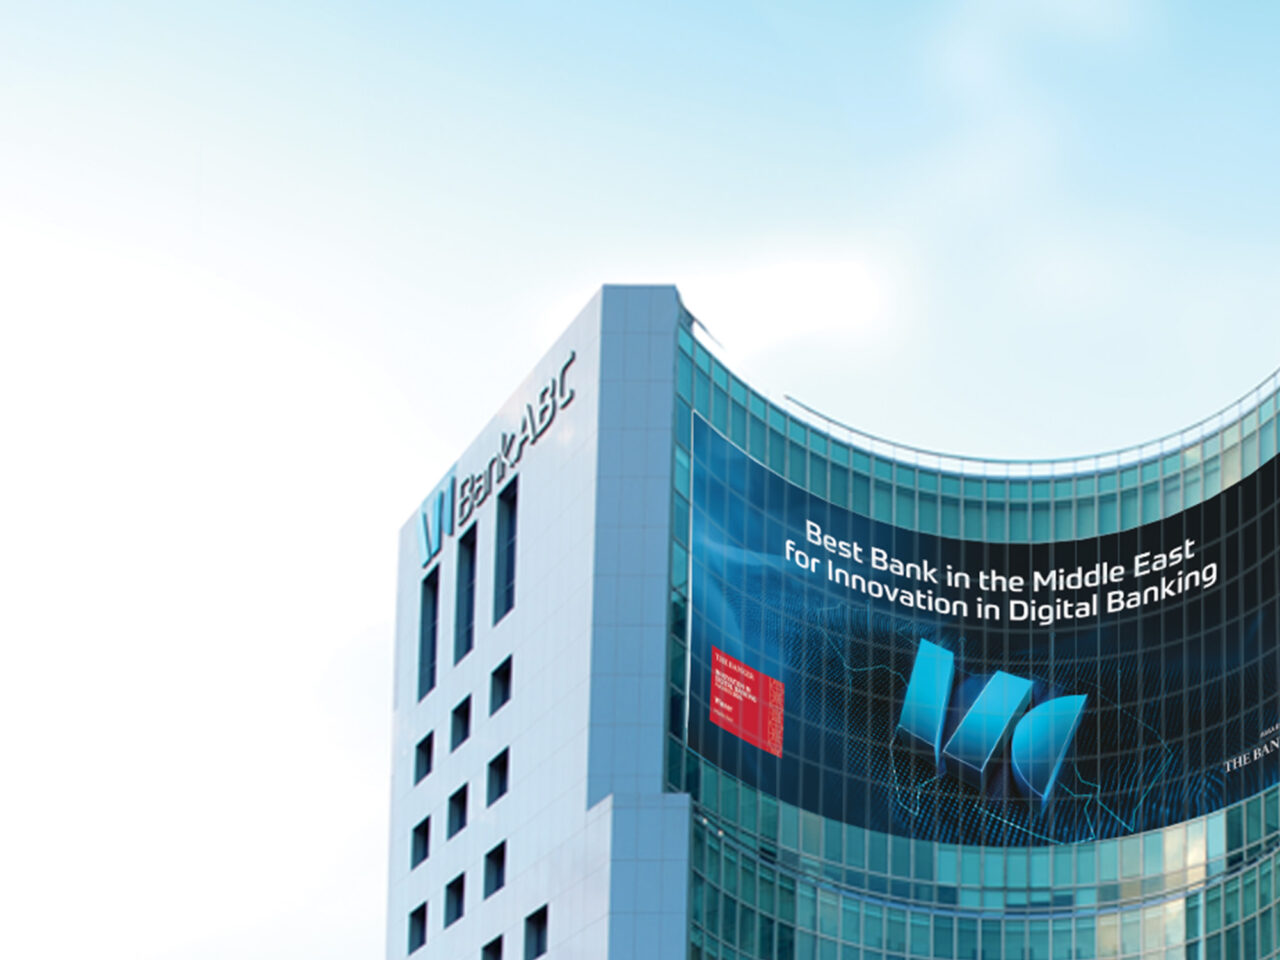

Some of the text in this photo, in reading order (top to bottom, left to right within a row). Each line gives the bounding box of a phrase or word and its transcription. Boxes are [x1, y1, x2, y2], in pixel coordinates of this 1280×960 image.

[785, 539, 1217, 626] for Innovation in Digital Banking
[806, 519, 1195, 592] Best Bank in the Middle East
[1224, 752, 1251, 773] THE
